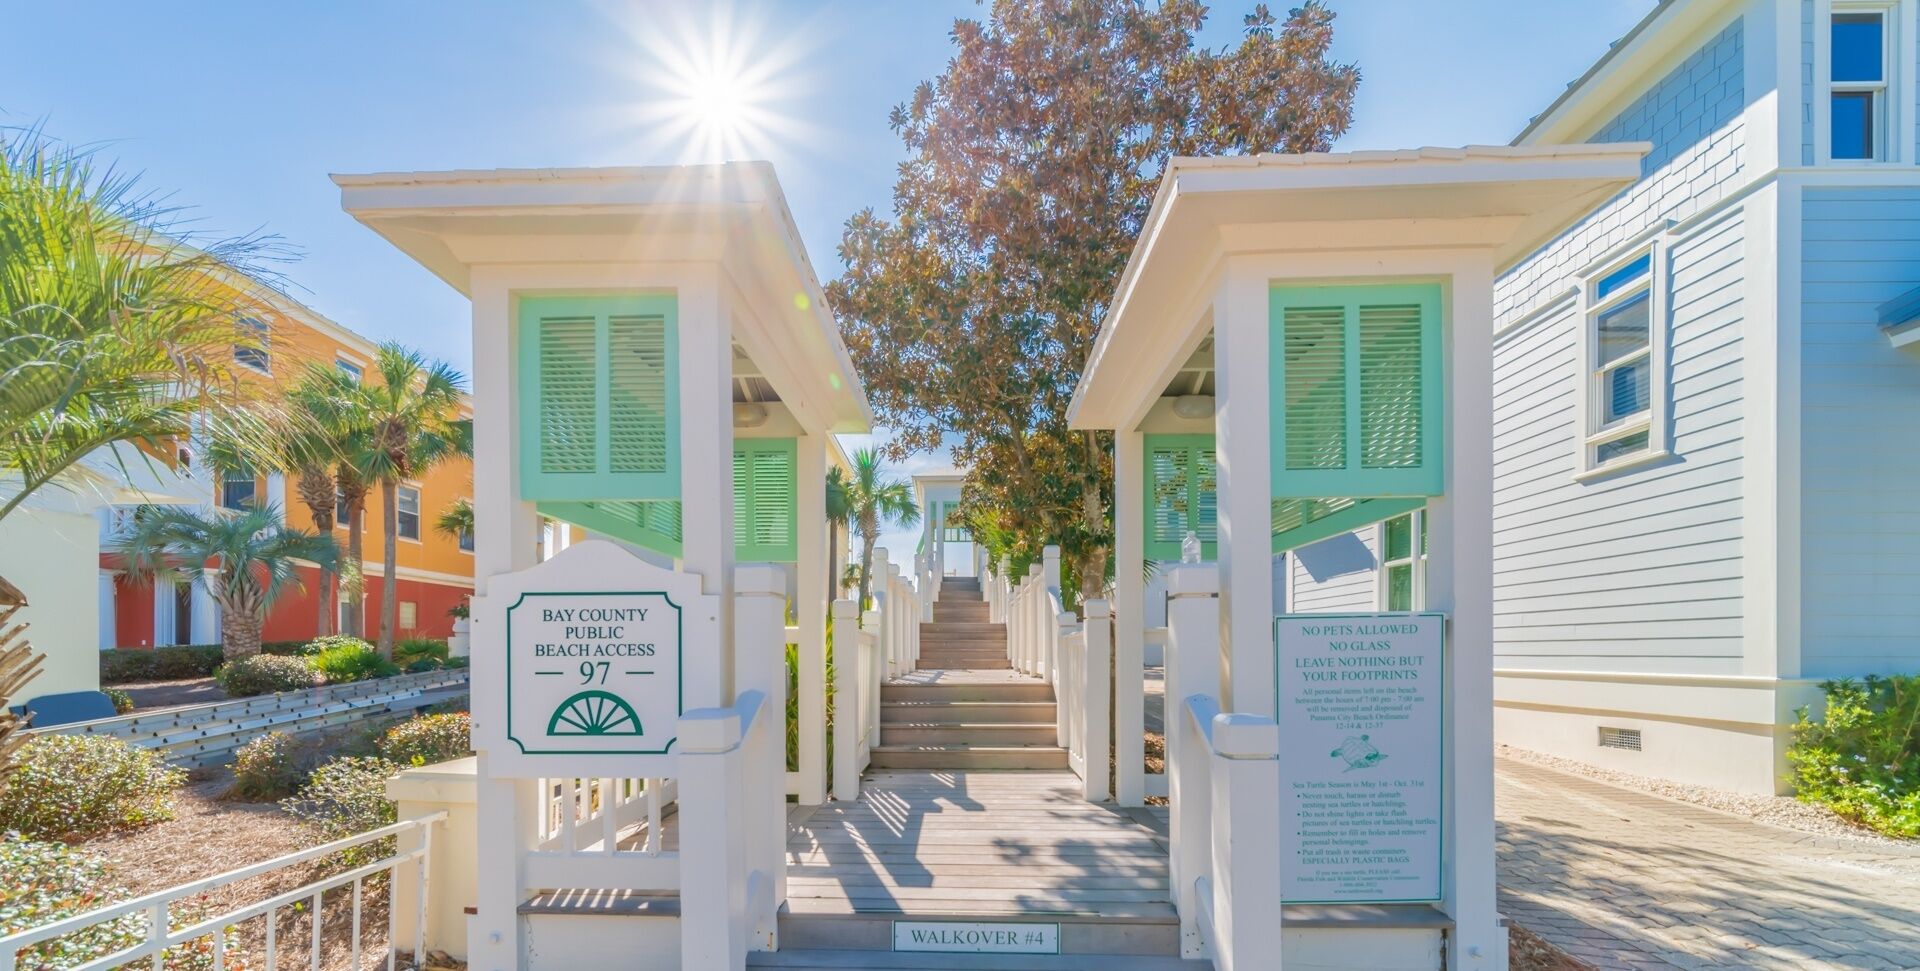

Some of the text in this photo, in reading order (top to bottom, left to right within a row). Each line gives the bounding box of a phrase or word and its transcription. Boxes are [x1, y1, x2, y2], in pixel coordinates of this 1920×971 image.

[543, 608, 649, 622] BAY COUNTY
[565, 626, 625, 640] PUBLIC
[1302, 624, 1419, 636] NO PETS ALLOWED
[535, 643, 655, 657] BEACH ACCESS
[1329, 640, 1391, 651] NO GLASS
[1295, 655, 1424, 668] LEAVE NOTHING BUT
[579, 661, 611, 686] 97
[1302, 669, 1418, 682] YOUR FOOTPRINTS
[911, 929, 1044, 945] WALKOVER #4
